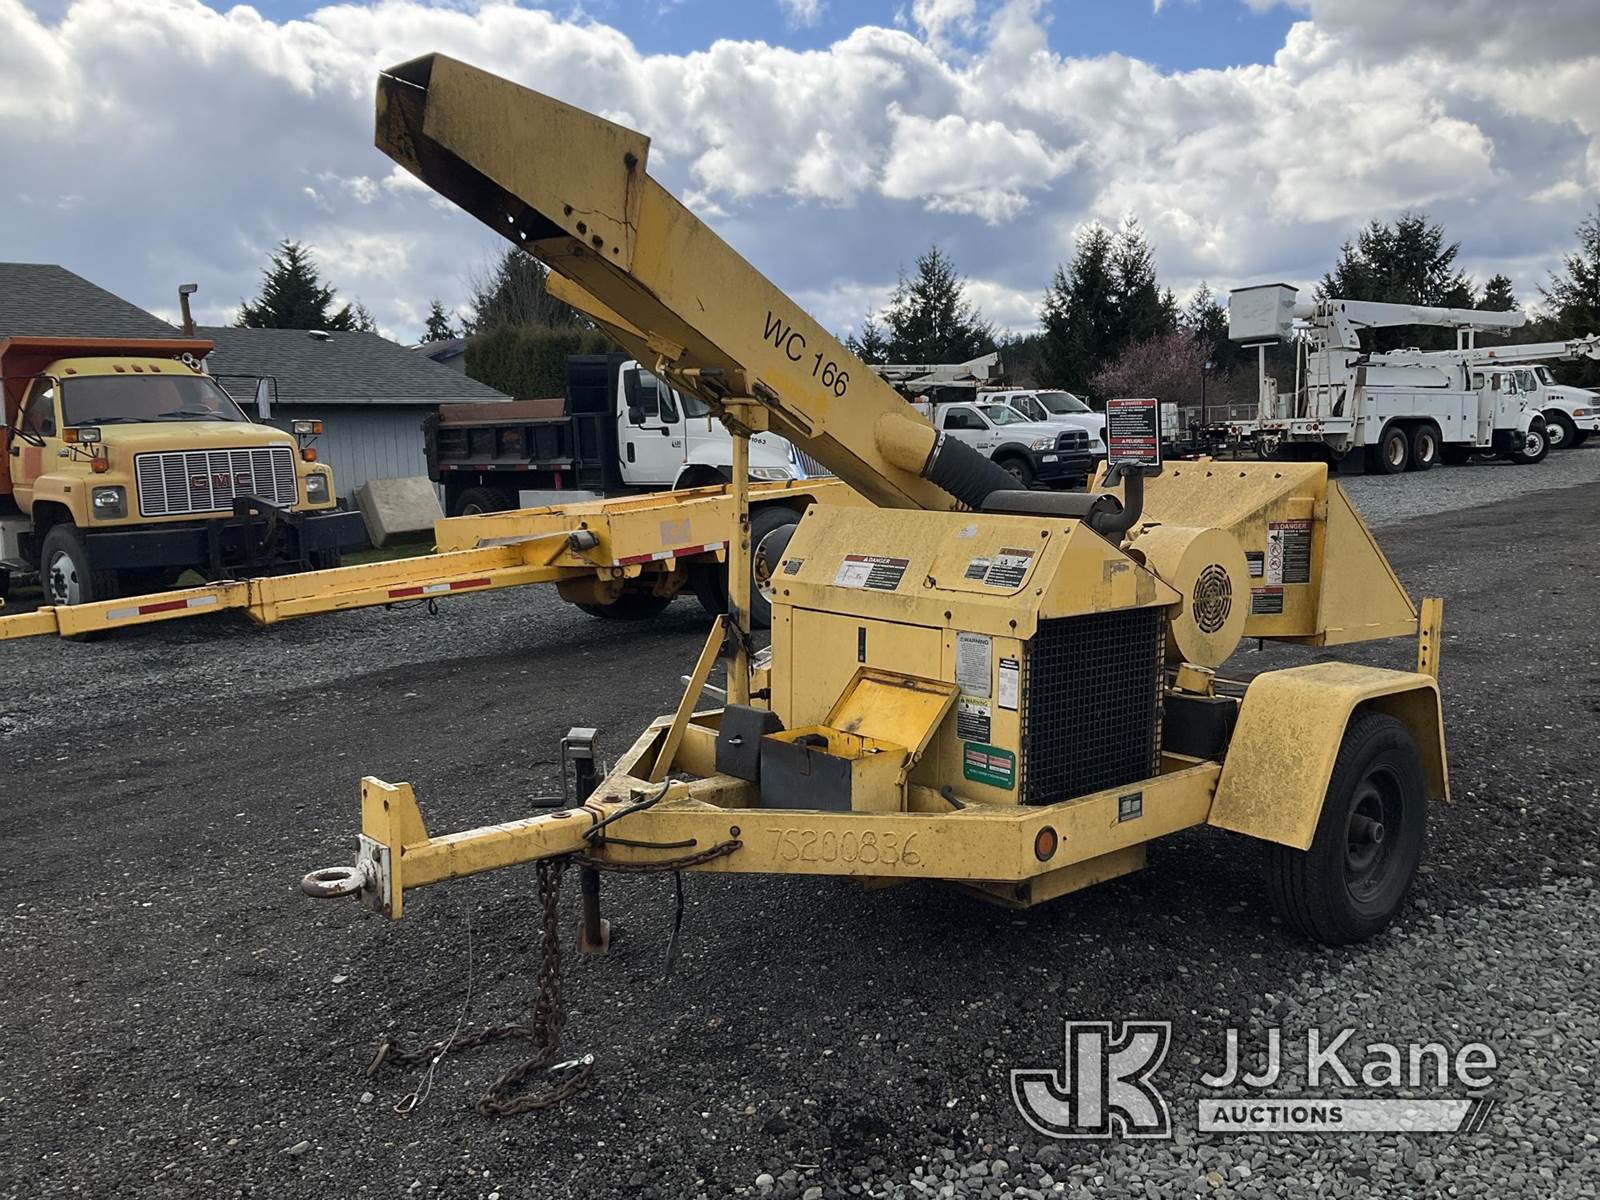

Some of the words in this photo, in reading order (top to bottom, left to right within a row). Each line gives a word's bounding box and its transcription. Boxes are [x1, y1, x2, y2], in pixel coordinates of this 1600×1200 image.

[763, 310, 806, 361] WC
[812, 352, 850, 397] 166
[191, 472, 251, 490] GMC
